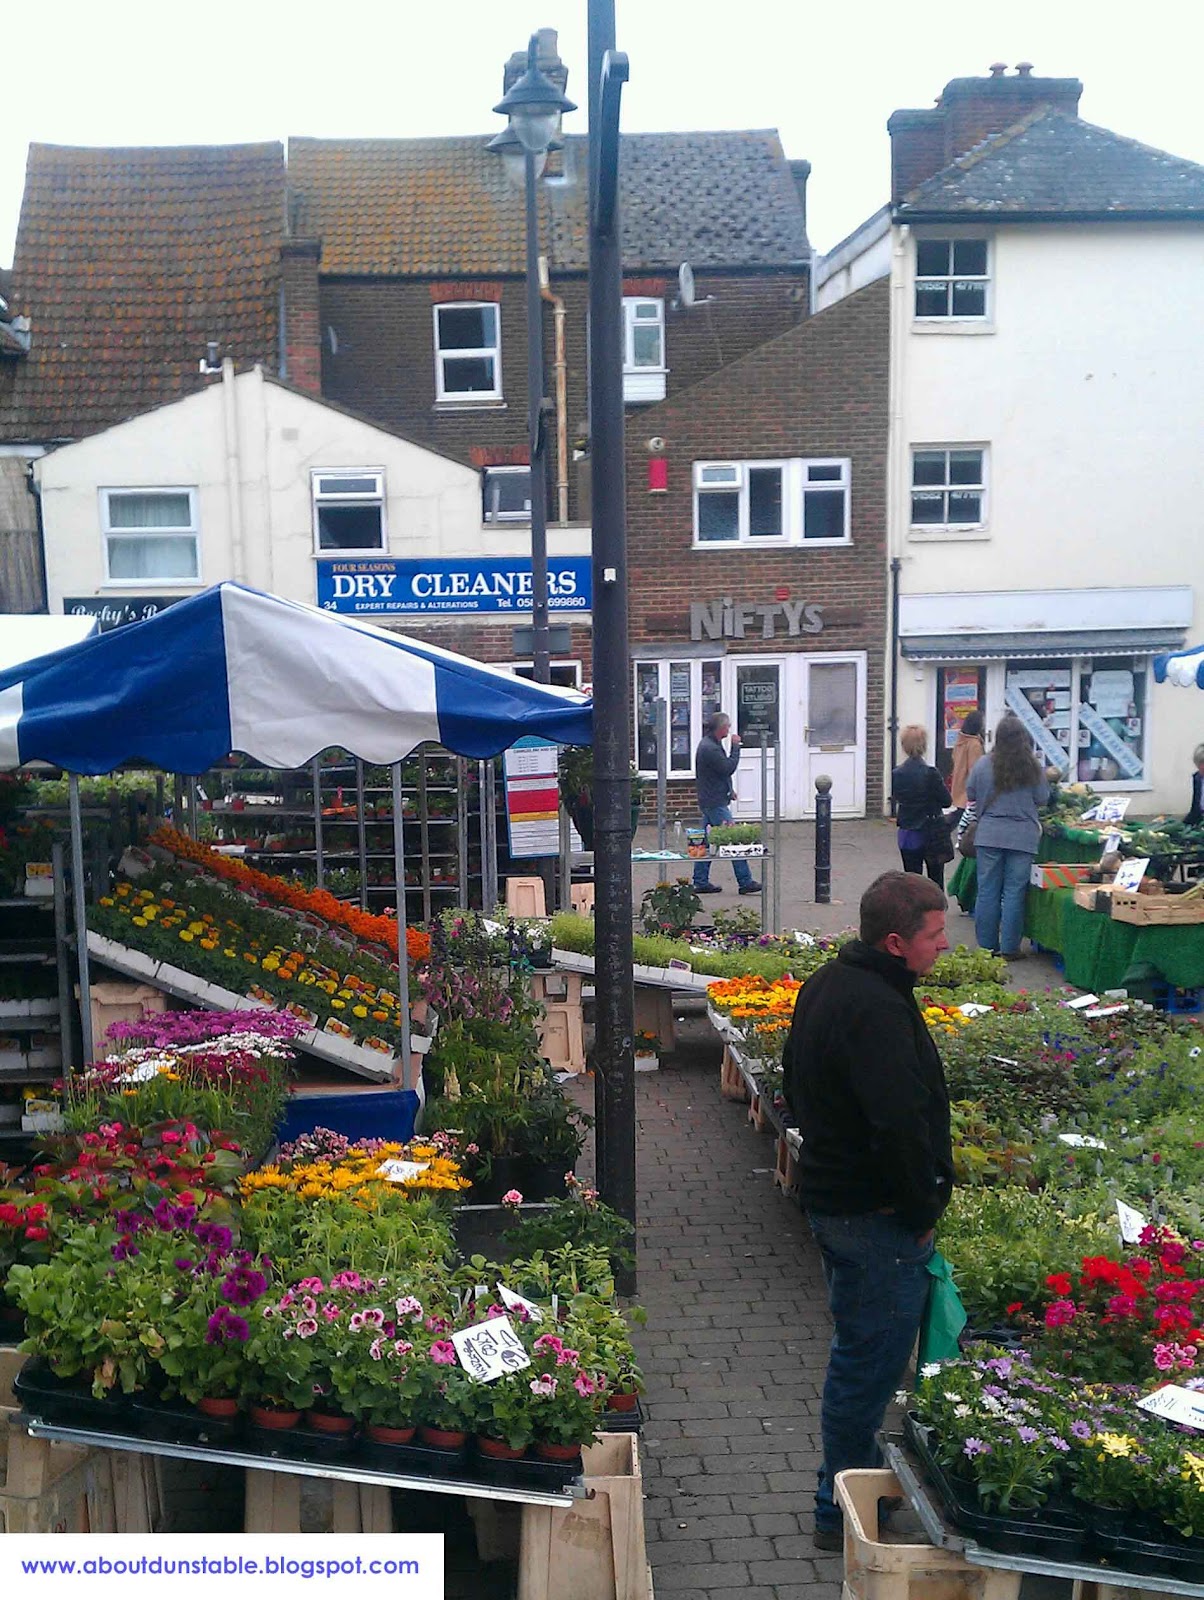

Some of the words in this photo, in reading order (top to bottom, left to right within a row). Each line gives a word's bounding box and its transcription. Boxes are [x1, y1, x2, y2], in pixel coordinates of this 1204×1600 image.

[333, 563, 357, 572] FOUR
[357, 563, 396, 571] SEASONS
[332, 574, 397, 598] DRY
[323, 601, 337, 610] 34
[355, 602, 384, 610] EXPERT
[547, 597, 586, 607] 699860
